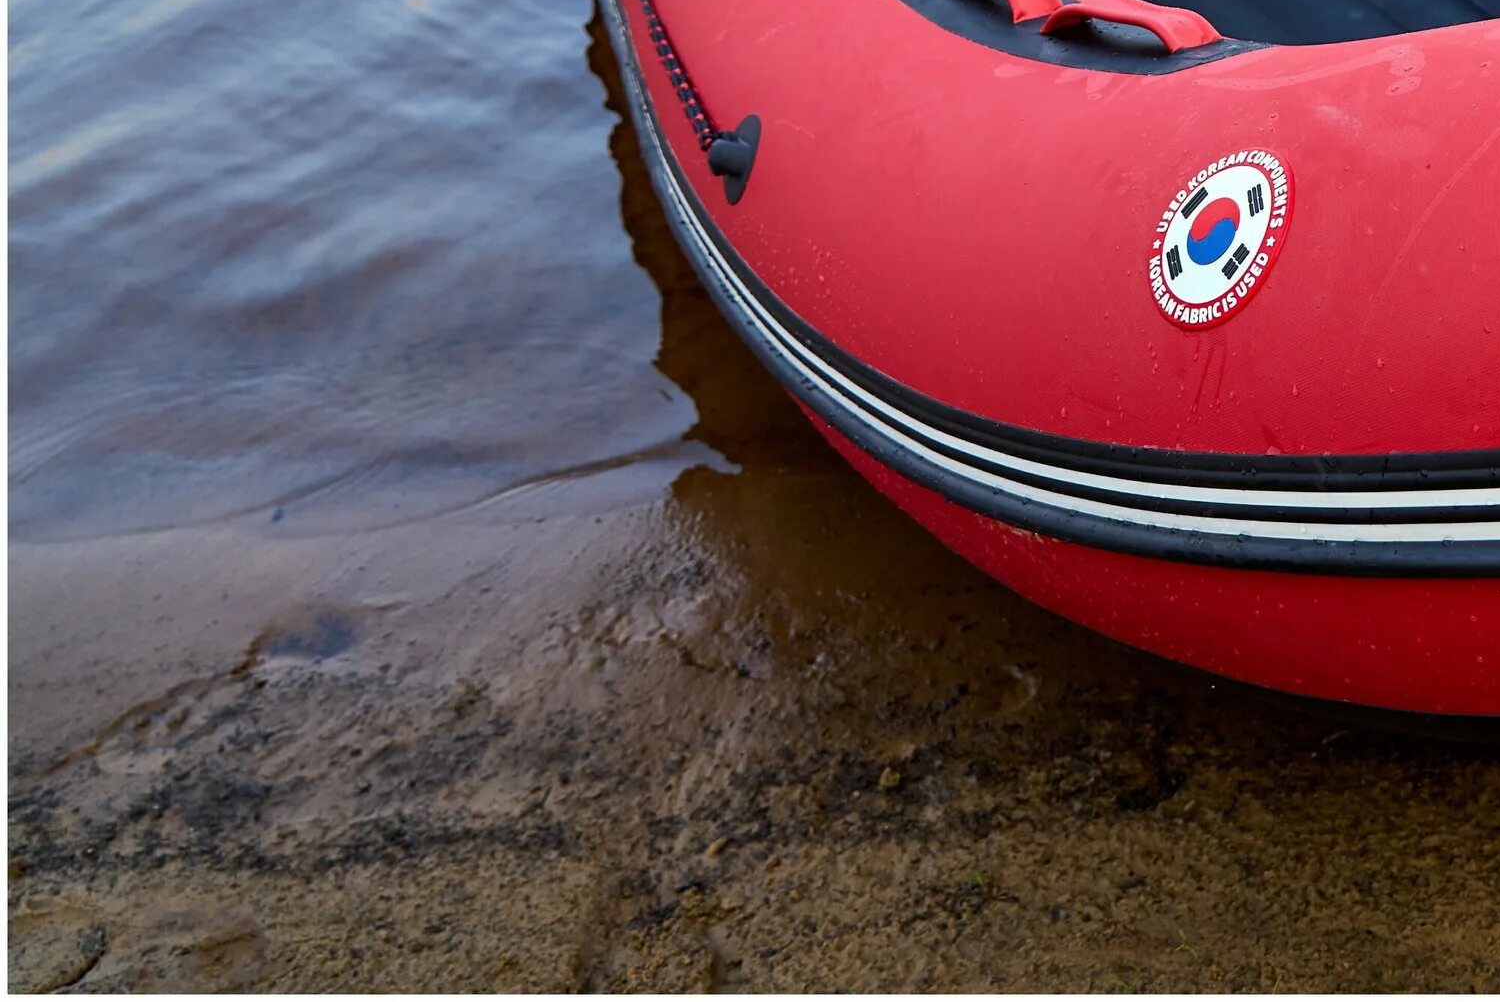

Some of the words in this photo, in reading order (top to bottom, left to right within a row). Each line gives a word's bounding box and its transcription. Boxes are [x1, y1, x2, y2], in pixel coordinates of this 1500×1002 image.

[1156, 189, 1188, 233] USED
[1188, 150, 1248, 191] KOREAN
[1246, 150, 1288, 229] COMPONENTS
[1149, 255, 1177, 316] KOREAN
[1174, 303, 1222, 324] FABRIC
[1223, 295, 1238, 313] IS
[1236, 252, 1269, 298] USED
